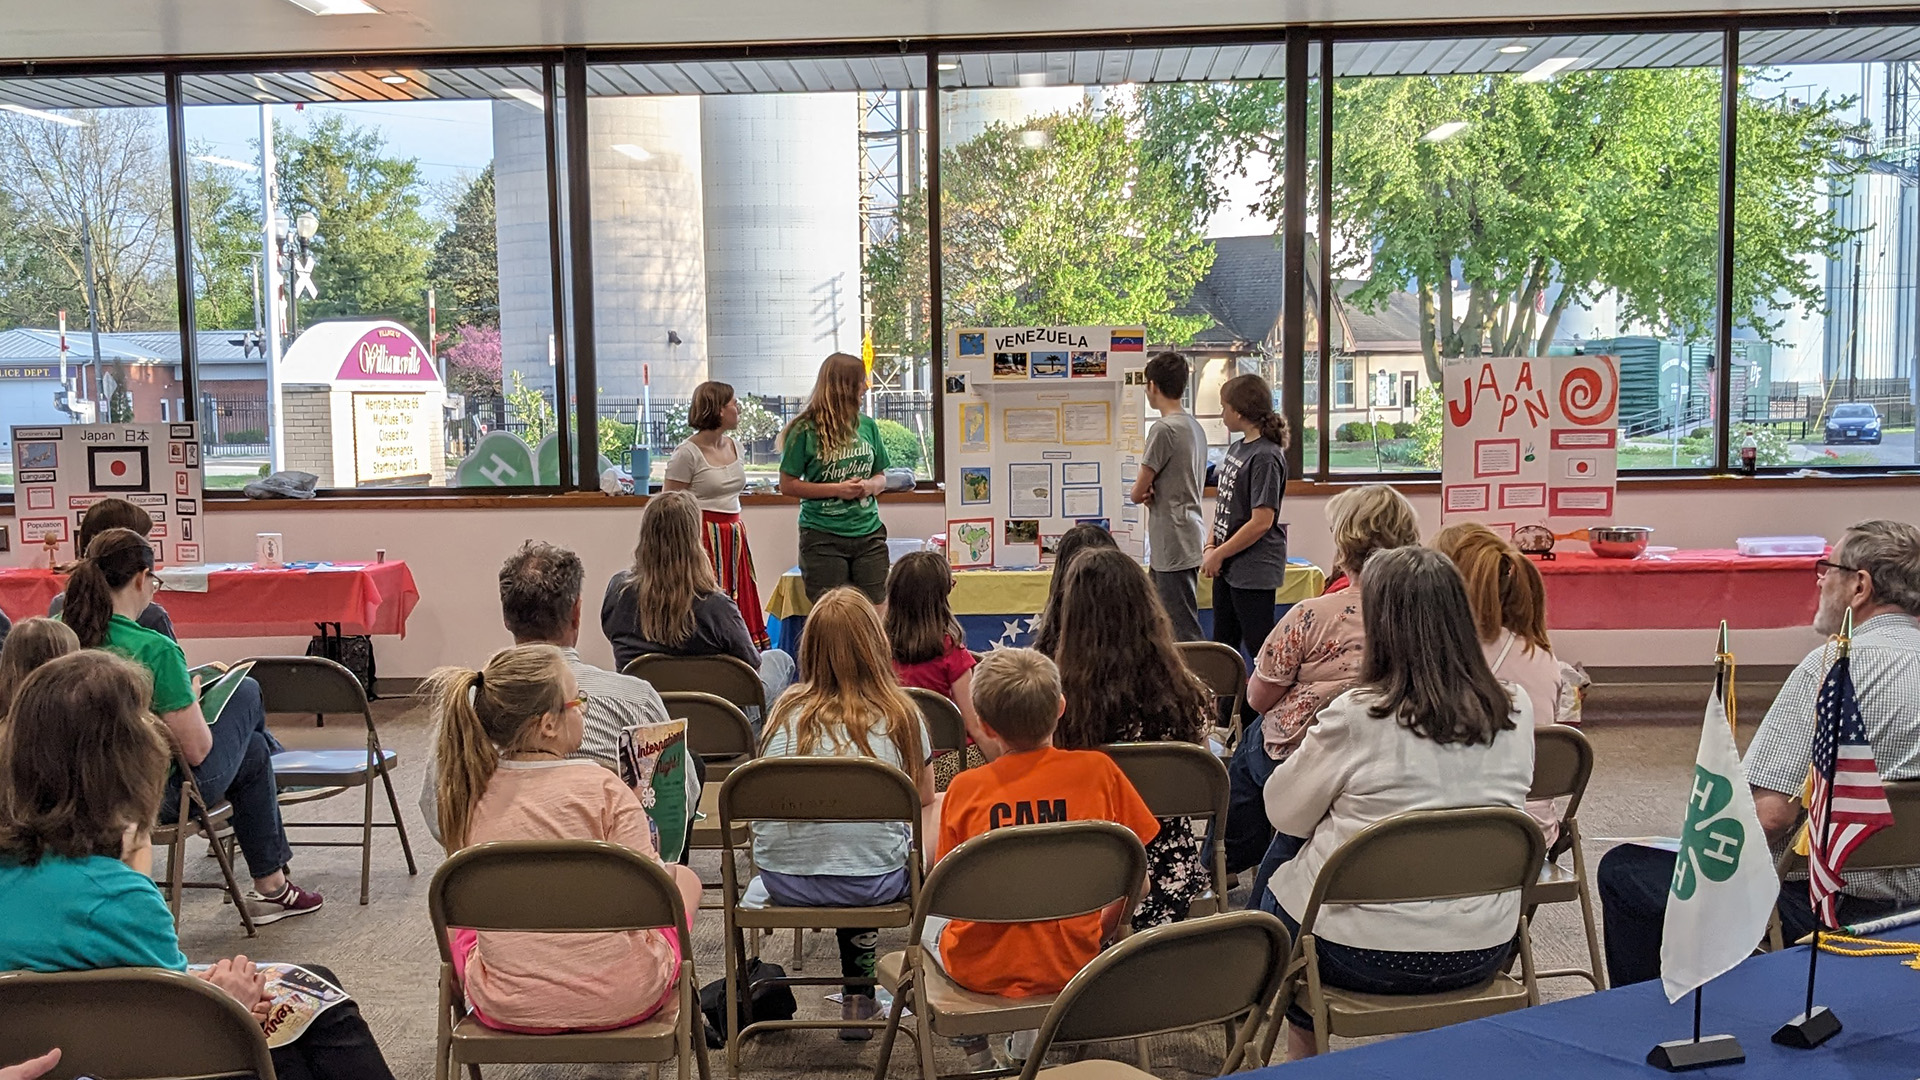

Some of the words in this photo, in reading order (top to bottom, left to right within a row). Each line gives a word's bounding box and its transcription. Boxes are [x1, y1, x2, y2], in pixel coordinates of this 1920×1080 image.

[995, 328, 1088, 350] VENEZUELA
[359, 341, 421, 375] Williamsville
[365, 398, 391, 412] Heritage
[394, 397, 410, 409] Route
[412, 397, 419, 409] 66
[80, 430, 115, 442] Japan
[125, 429, 150, 442] 日本
[379, 429, 399, 441] Closed
[401, 428, 409, 440] for
[376, 445, 413, 457] Maintenance
[373, 461, 397, 475] Starting
[821, 460, 875, 483] Anything
[989, 798, 1068, 831] CAM
